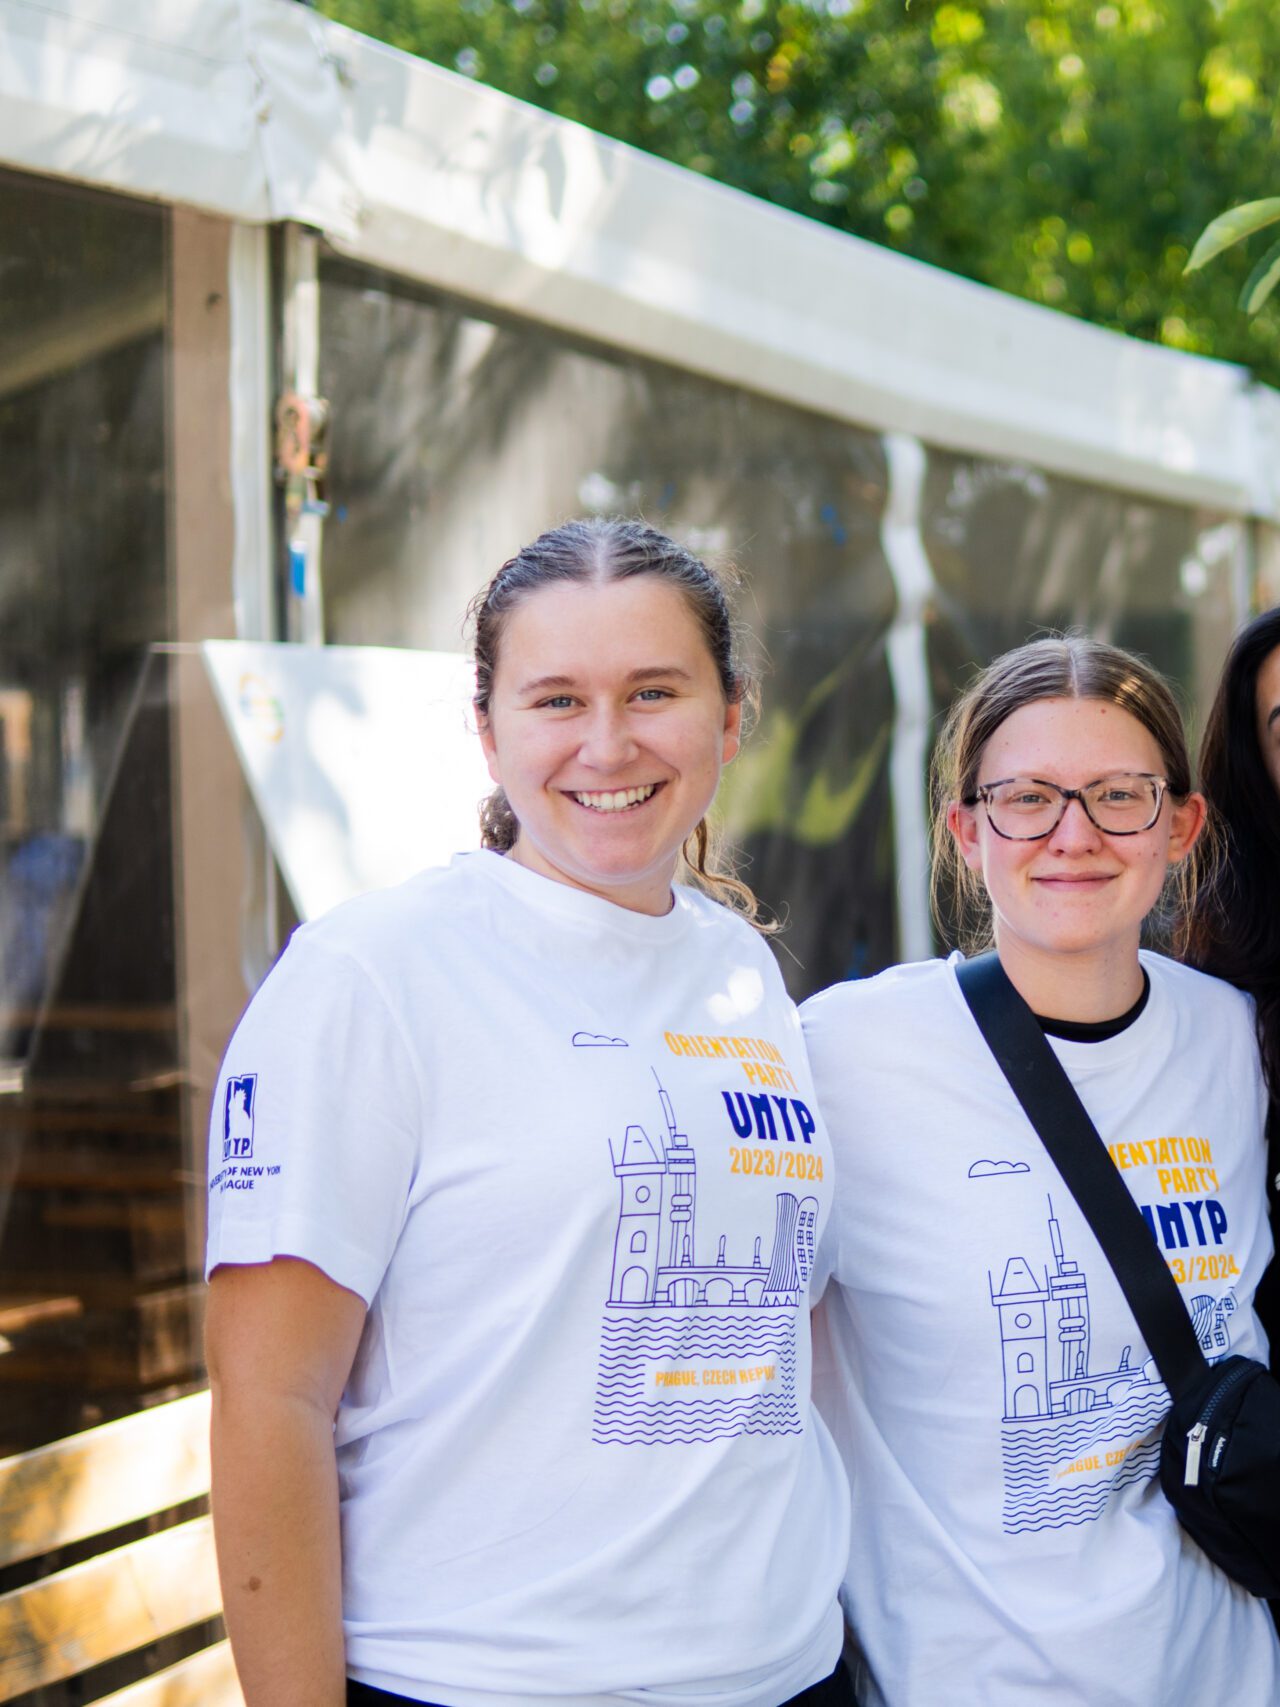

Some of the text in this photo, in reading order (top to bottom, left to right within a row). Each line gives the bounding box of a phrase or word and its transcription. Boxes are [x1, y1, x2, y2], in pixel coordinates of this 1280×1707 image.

[664, 1031, 786, 1066] ORIENTATION
[741, 1061, 798, 1093] PARTY
[721, 1091, 815, 1144] UNYP
[224, 1137, 250, 1158] YP
[1108, 1136, 1213, 1169] IENTATION
[240, 1166, 264, 1176] NEW
[728, 1147, 823, 1182] 2023/2024
[1157, 1167, 1219, 1194] PARTY
[1166, 1253, 1240, 1284] 3/2024
[702, 1367, 737, 1386] CZECH
